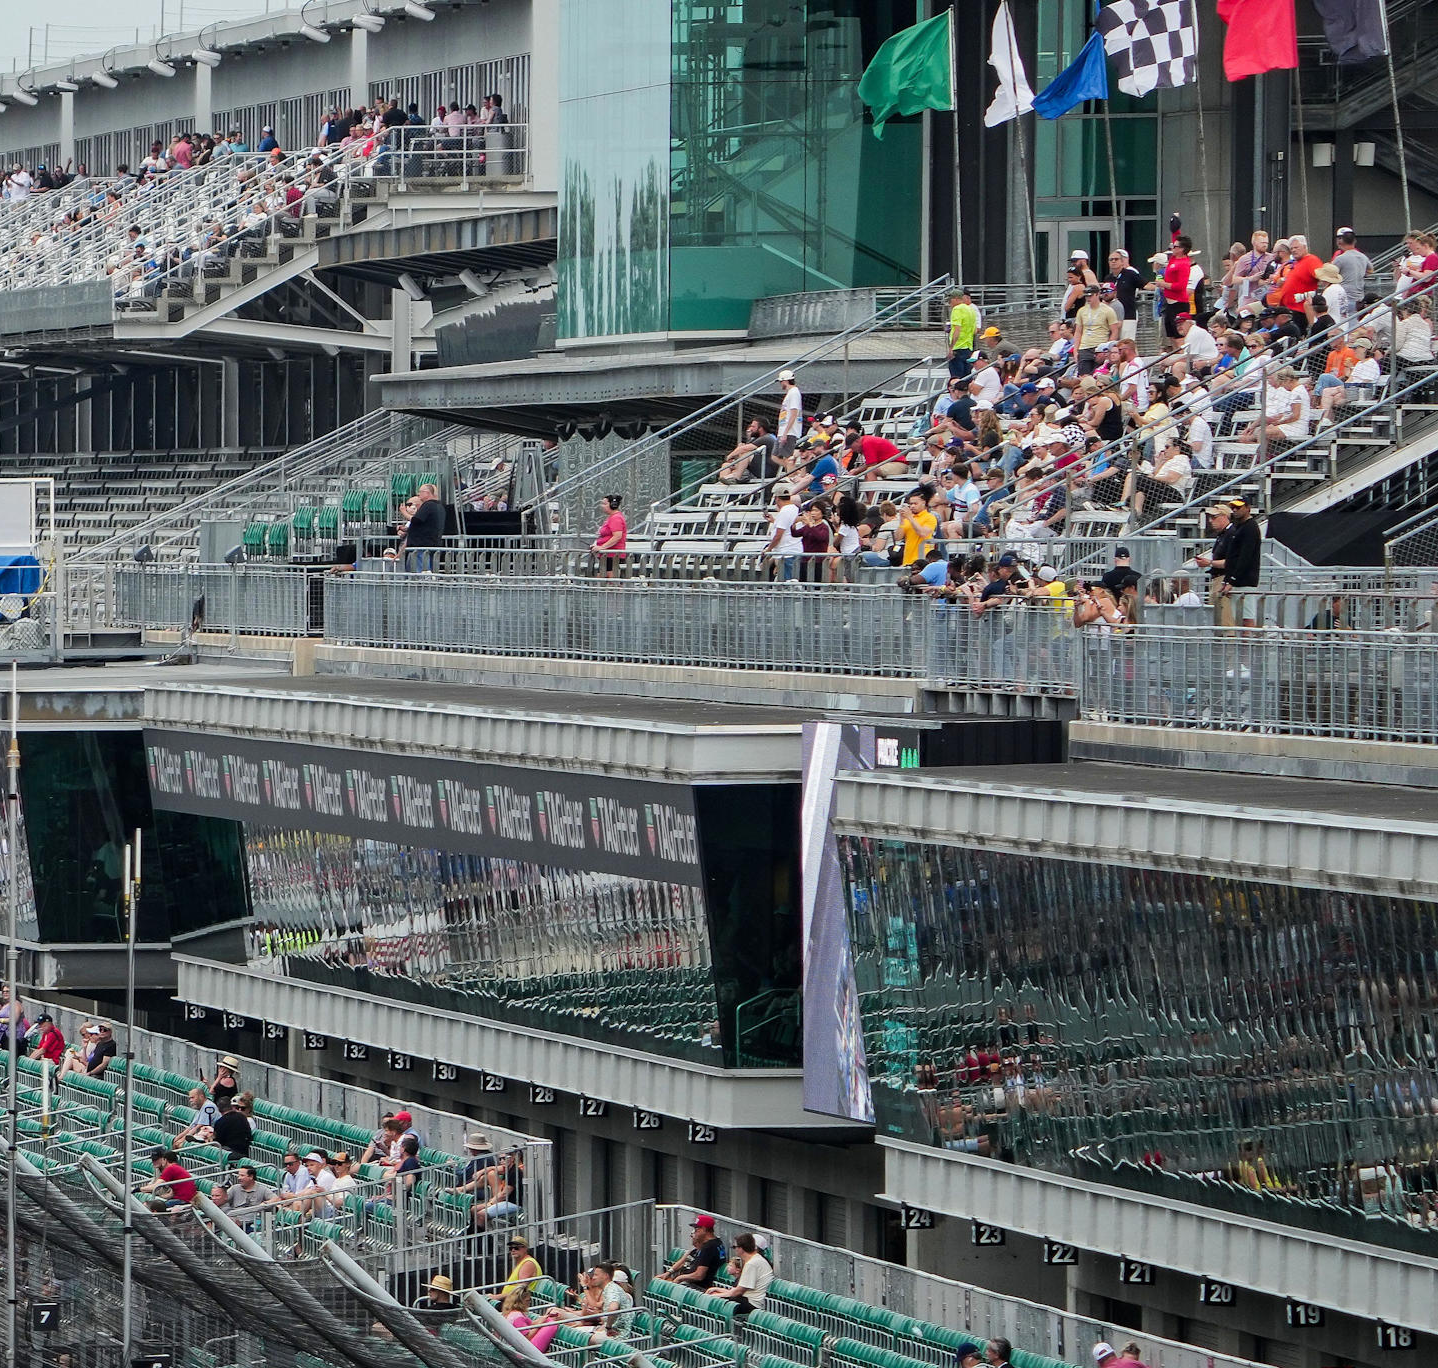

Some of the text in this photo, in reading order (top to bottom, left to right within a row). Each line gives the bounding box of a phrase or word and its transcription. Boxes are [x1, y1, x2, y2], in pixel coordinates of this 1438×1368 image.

[267, 1025, 284, 1038] 34
[308, 1035, 324, 1048] 33
[350, 1045, 366, 1058] 32
[395, 1055, 411, 1069] 31
[438, 1065, 456, 1080] 30
[485, 1076, 504, 1091] 29
[535, 1087, 554, 1103] 28
[586, 1099, 605, 1116] 27
[640, 1112, 660, 1128] 26
[695, 1125, 715, 1142] 25
[909, 1208, 931, 1228] 24
[979, 1225, 1002, 1244] 23
[1052, 1245, 1075, 1263] 22
[1129, 1263, 1151, 1282] 21
[1210, 1284, 1232, 1303] 20
[40, 1311, 51, 1325] 7
[1296, 1305, 1321, 1325] 19
[1386, 1327, 1411, 1347] 18
